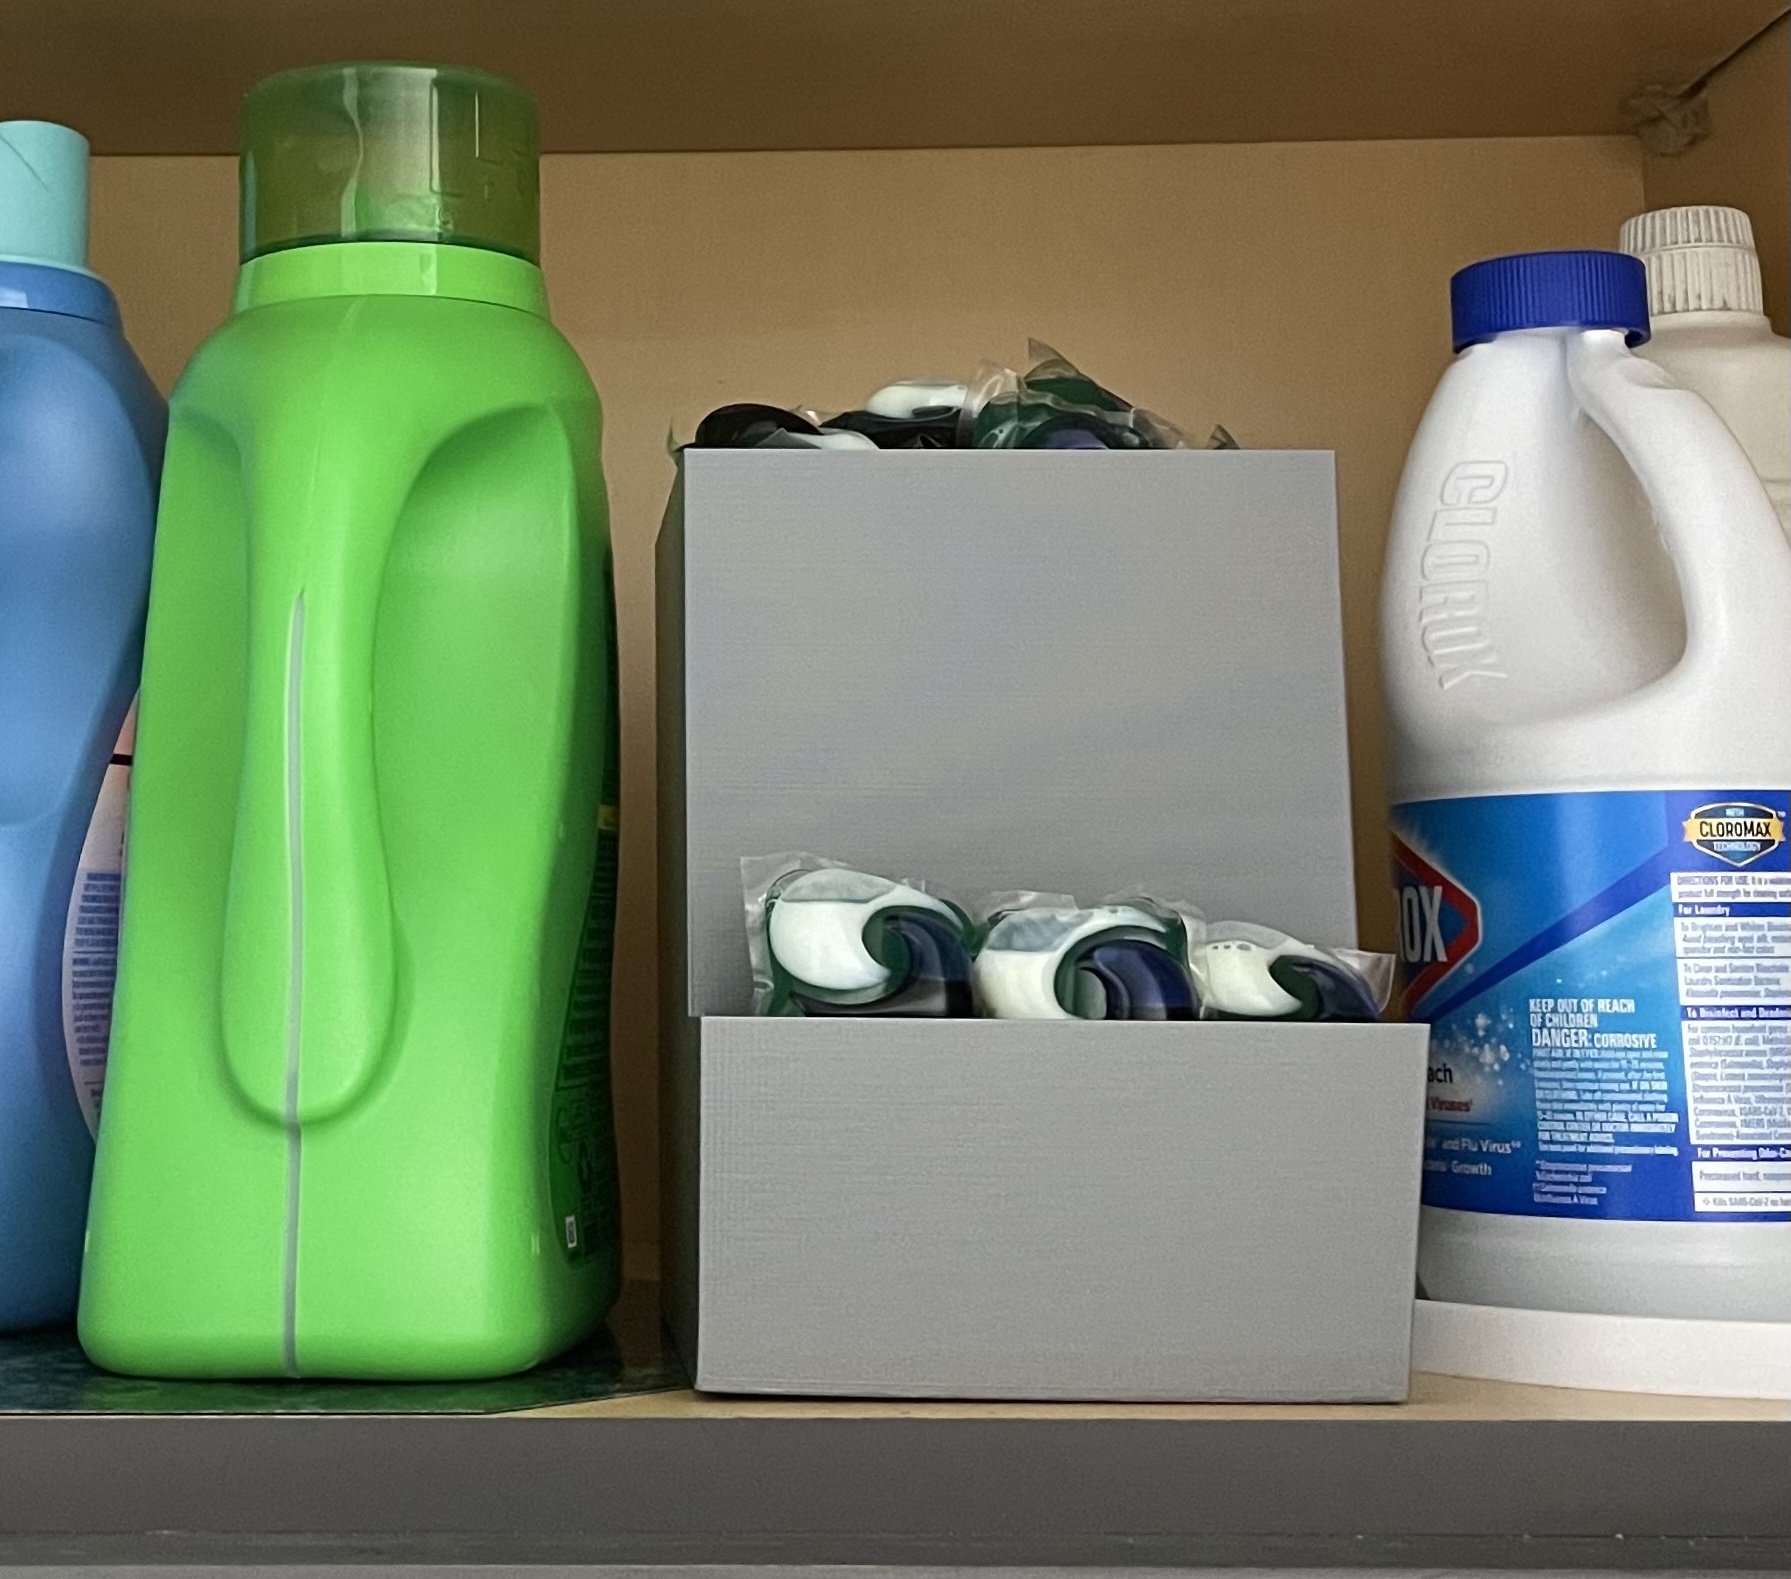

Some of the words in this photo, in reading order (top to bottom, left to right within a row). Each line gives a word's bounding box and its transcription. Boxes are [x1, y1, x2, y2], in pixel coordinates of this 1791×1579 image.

[1418, 461, 1508, 690] CLOROX
[1678, 903, 1692, 915] For
[1694, 904, 1730, 917] Laundry
[1528, 998, 1554, 1013] KEEP
[1557, 998, 1578, 1013] OUT
[1580, 998, 1595, 1013] OF
[1597, 998, 1636, 1014] REACH
[1529, 1013, 1545, 1028] OF
[1545, 1013, 1599, 1029] CHILDREN
[1531, 1028, 1593, 1048] DANGER:
[1593, 1033, 1658, 1049] CORROSIVE
